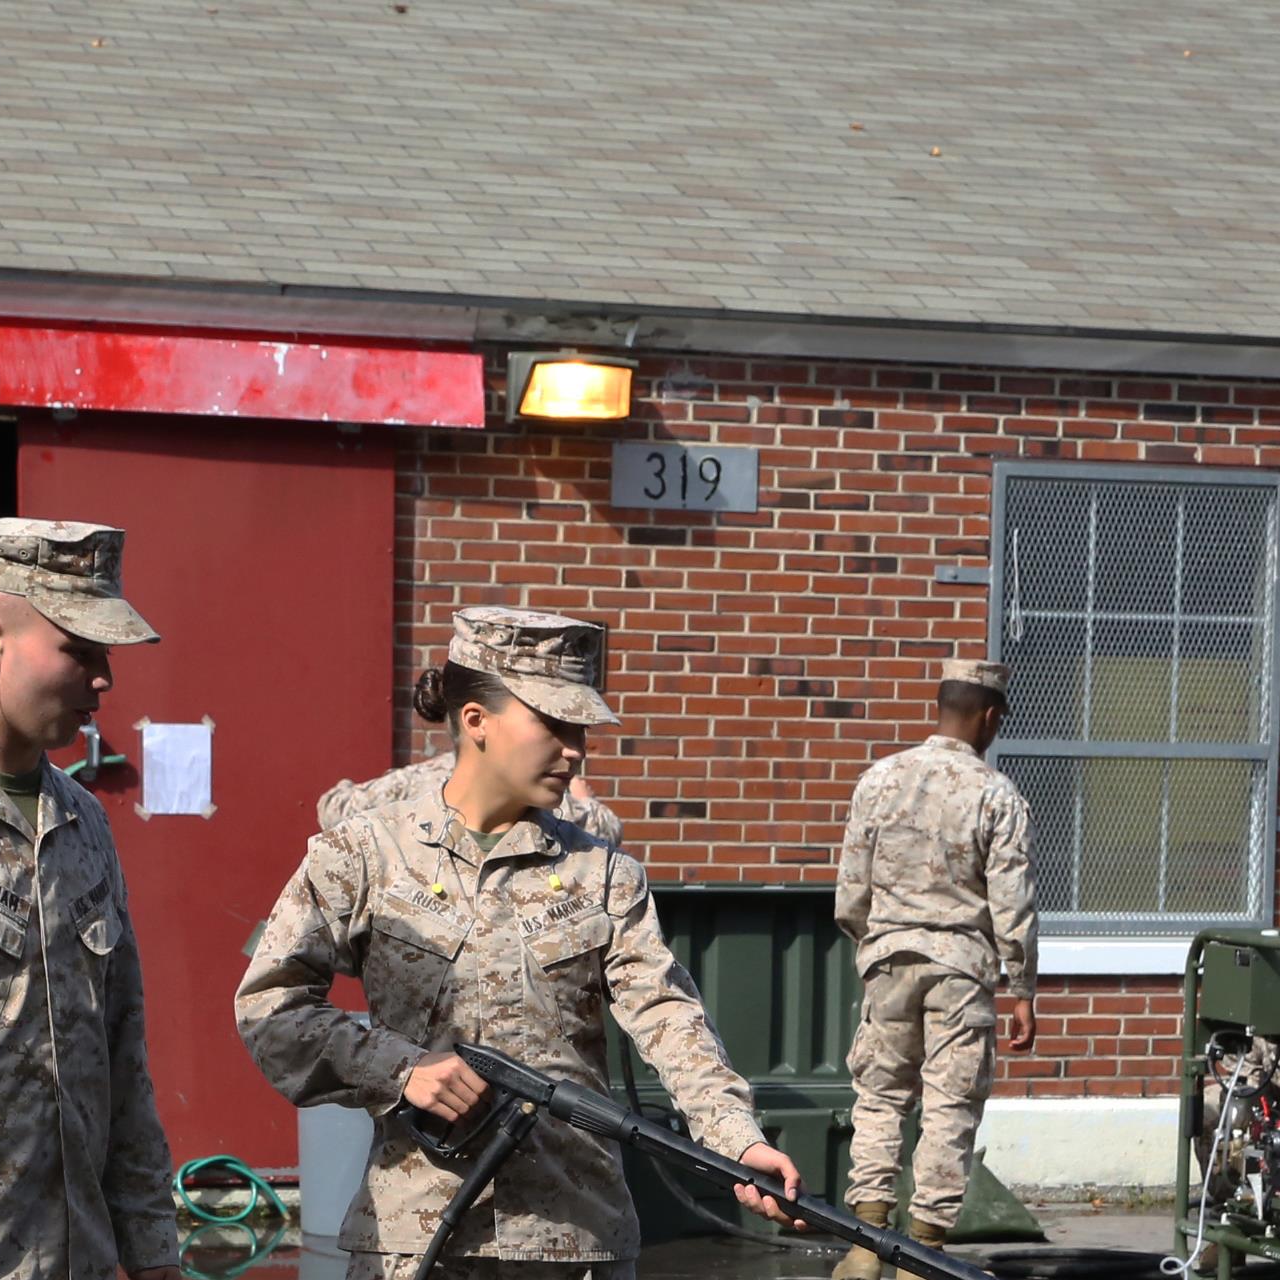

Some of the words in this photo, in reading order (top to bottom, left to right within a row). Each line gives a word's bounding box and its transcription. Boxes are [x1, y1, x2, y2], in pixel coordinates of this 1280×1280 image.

[643, 450, 722, 502] 319
[521, 916, 545, 934] U.S.
[547, 893, 595, 922] MARINES
